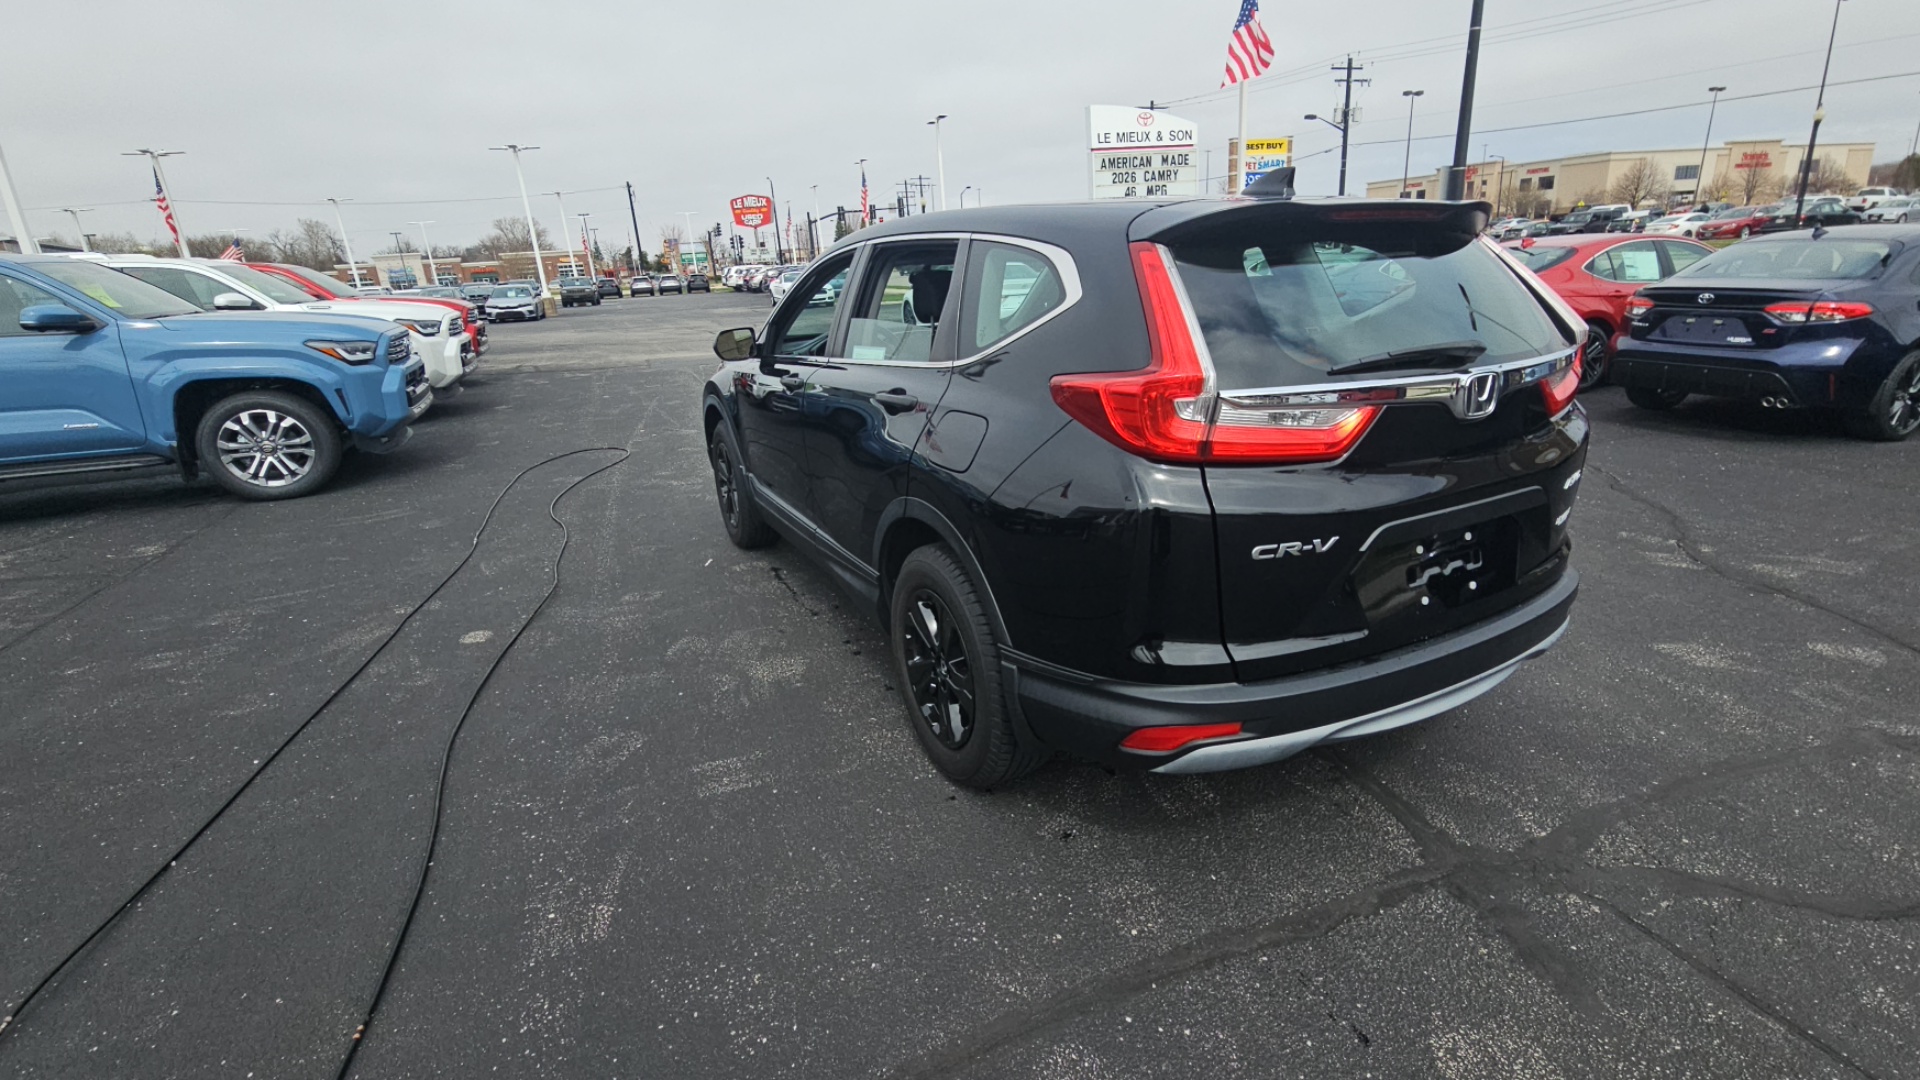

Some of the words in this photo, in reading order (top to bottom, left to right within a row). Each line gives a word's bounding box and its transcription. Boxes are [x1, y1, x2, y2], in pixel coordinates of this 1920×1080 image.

[1097, 132, 1111, 144] LE
[1116, 131, 1151, 143] MIEUX
[1156, 130, 1163, 142] &
[1169, 129, 1192, 141] SON
[1100, 155, 1152, 170] AMERICAN
[1161, 153, 1190, 166] MADE
[1111, 171, 1137, 184] 2026
[1143, 169, 1179, 183] CAMRY
[1124, 186, 1137, 196] 46
[1146, 184, 1168, 196] MPG
[733, 199, 742, 208] LE
[743, 197, 767, 207] MIEUX
[1251, 536, 1340, 560] CR-V
